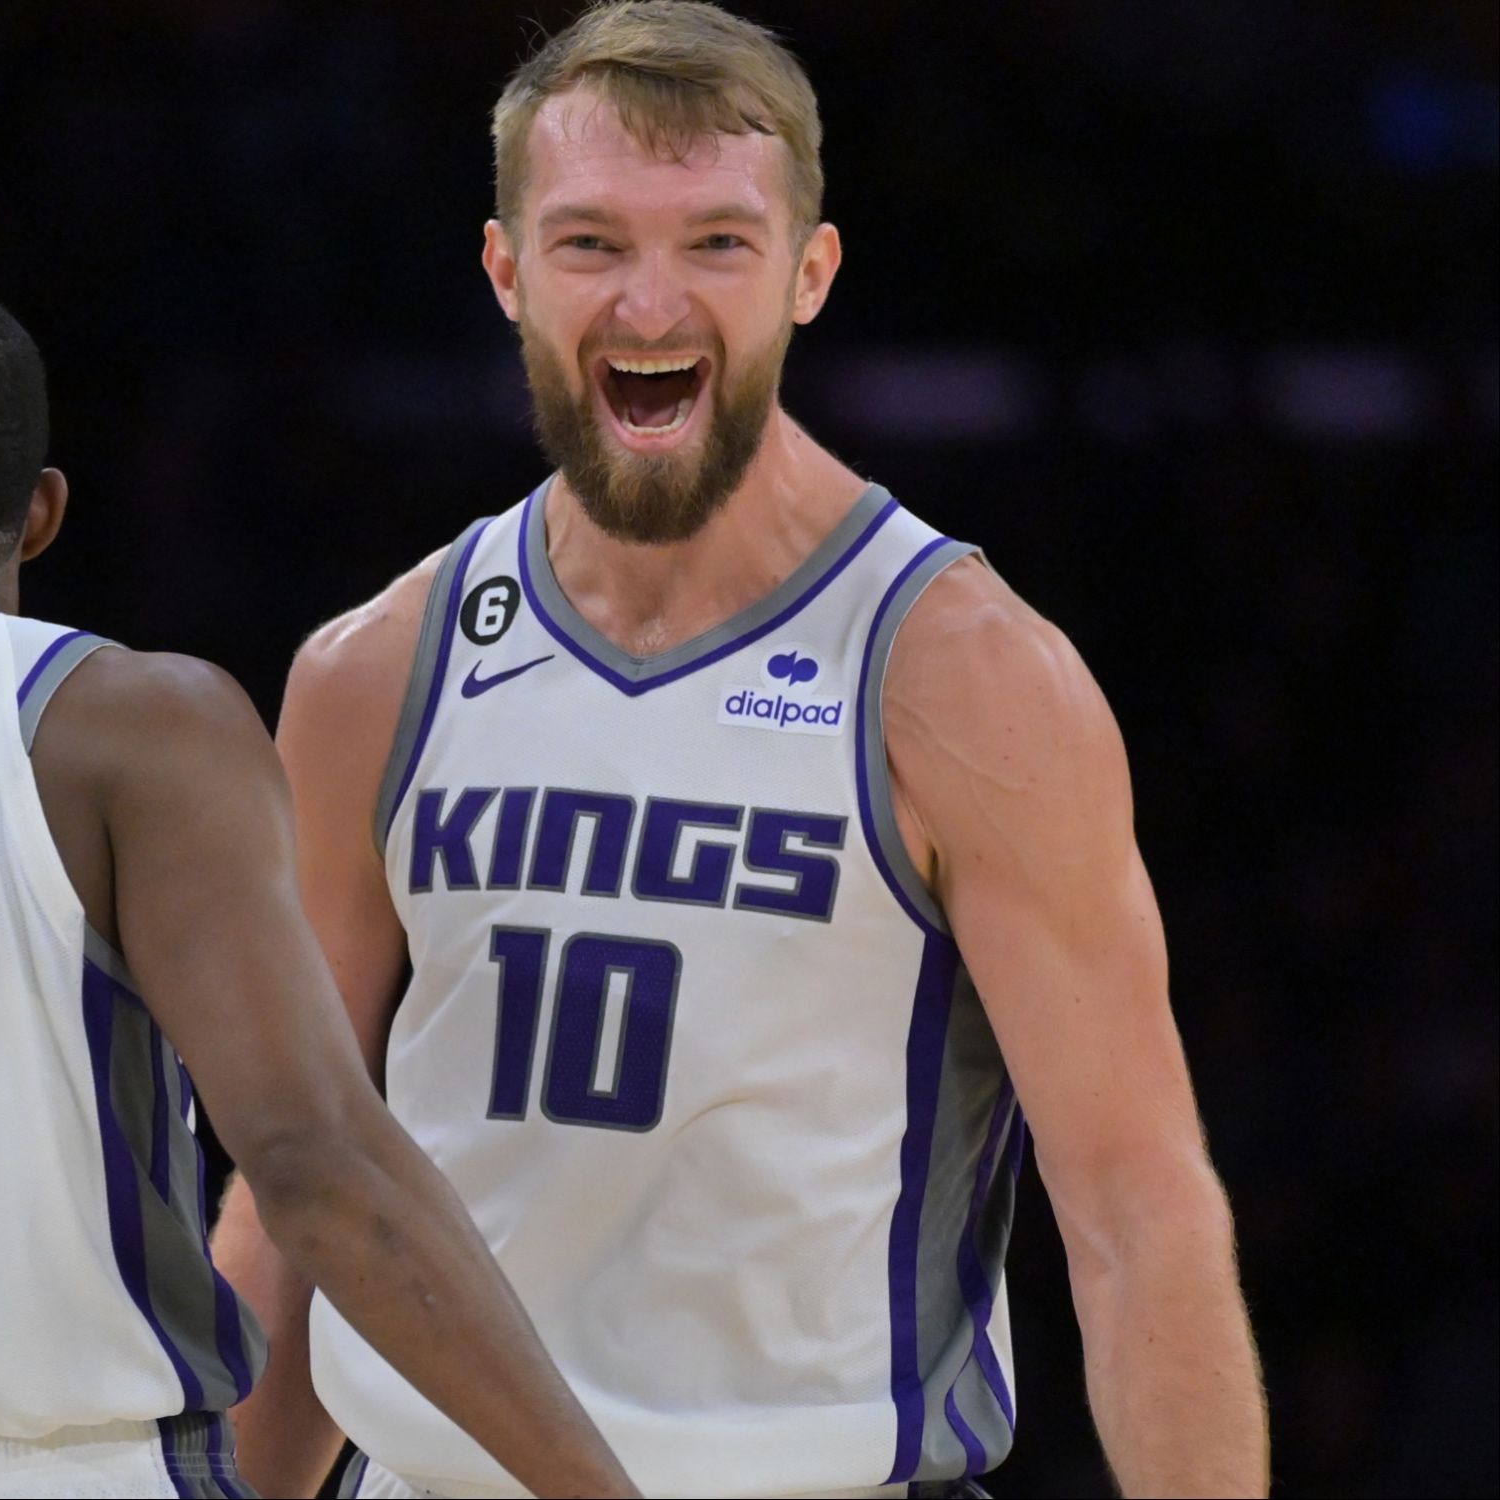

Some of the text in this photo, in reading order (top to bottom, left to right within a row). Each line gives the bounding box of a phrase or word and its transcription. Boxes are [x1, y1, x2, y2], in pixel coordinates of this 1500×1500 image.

[475, 585, 509, 637] 6
[725, 691, 843, 727] dialpad
[408, 786, 849, 923] KINGS
[485, 924, 683, 1134] 10
